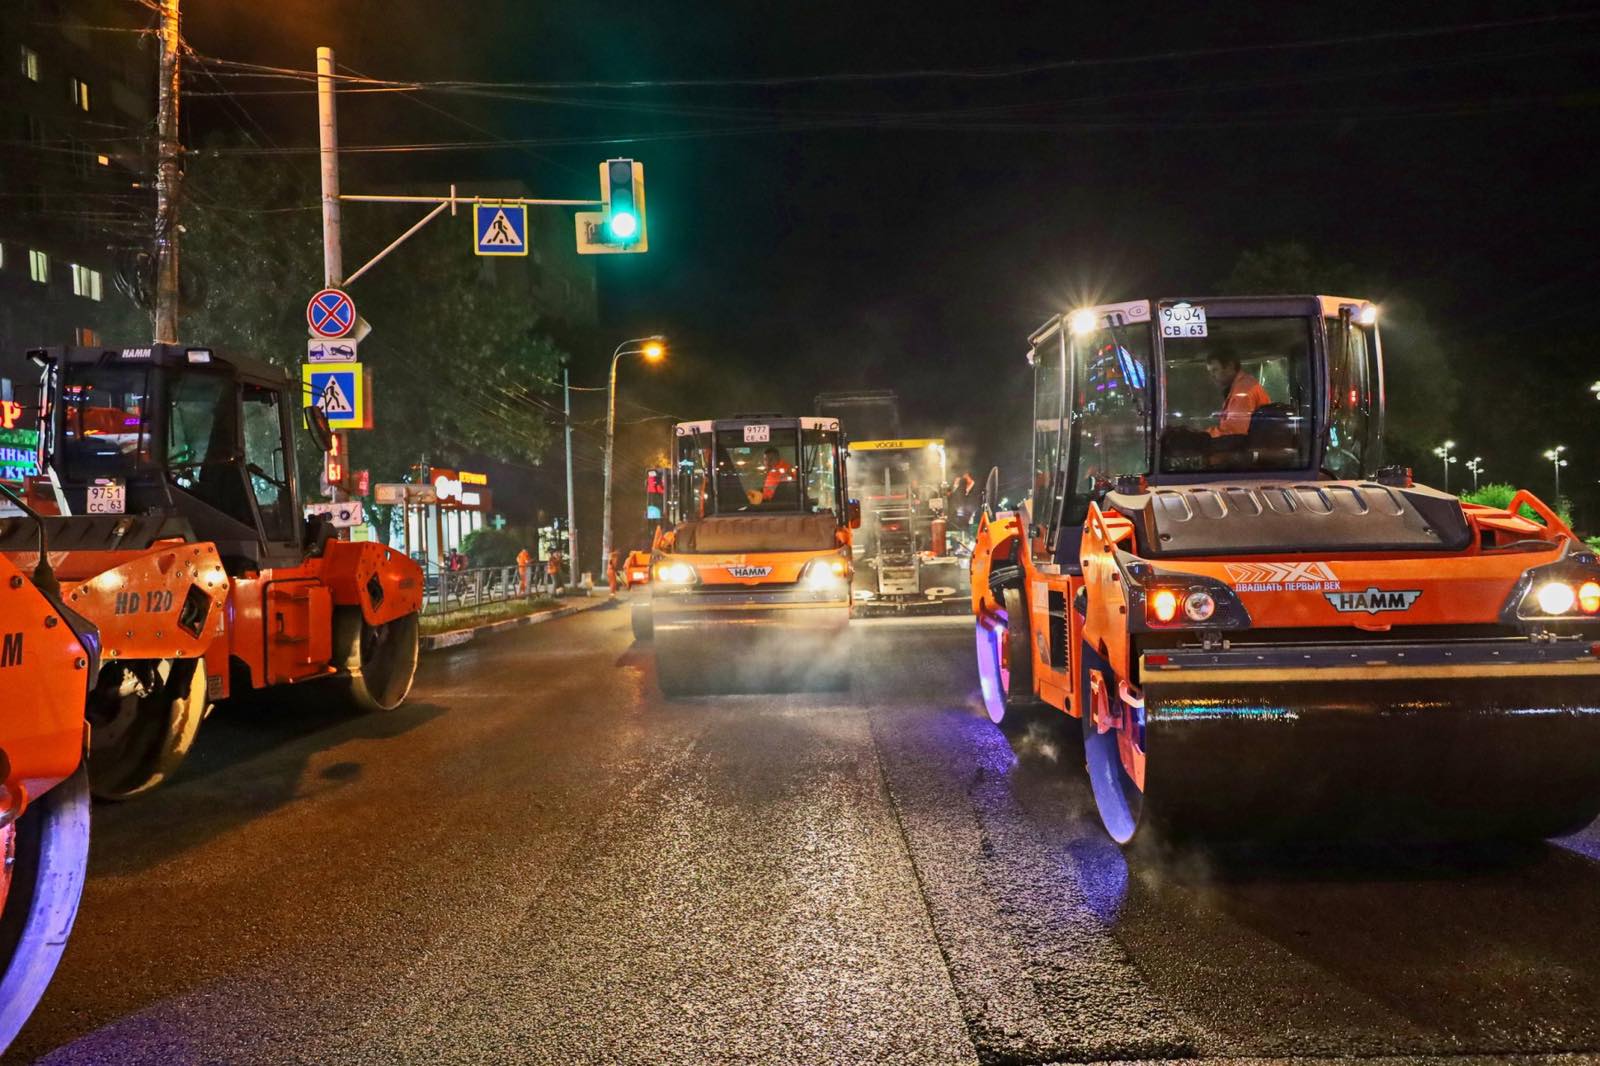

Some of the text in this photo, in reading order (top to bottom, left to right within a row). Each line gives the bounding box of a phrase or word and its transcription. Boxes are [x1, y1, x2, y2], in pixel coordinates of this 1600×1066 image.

[1163, 308, 1202, 322] 9004
[1189, 324, 1205, 336] 63
[122, 348, 152, 359] HAMM
[0, 400, 21, 430] Р
[0, 465, 38, 482] КТЫ
[91, 487, 122, 499] 9751
[110, 499, 123, 510] 63
[734, 567, 767, 577] HAMM
[1235, 581, 1341, 593] ДВАДЦАТЬ ПЕРВЫЙ ВЕК
[115, 590, 173, 614] HD 120
[1340, 592, 1406, 610] HAMM
